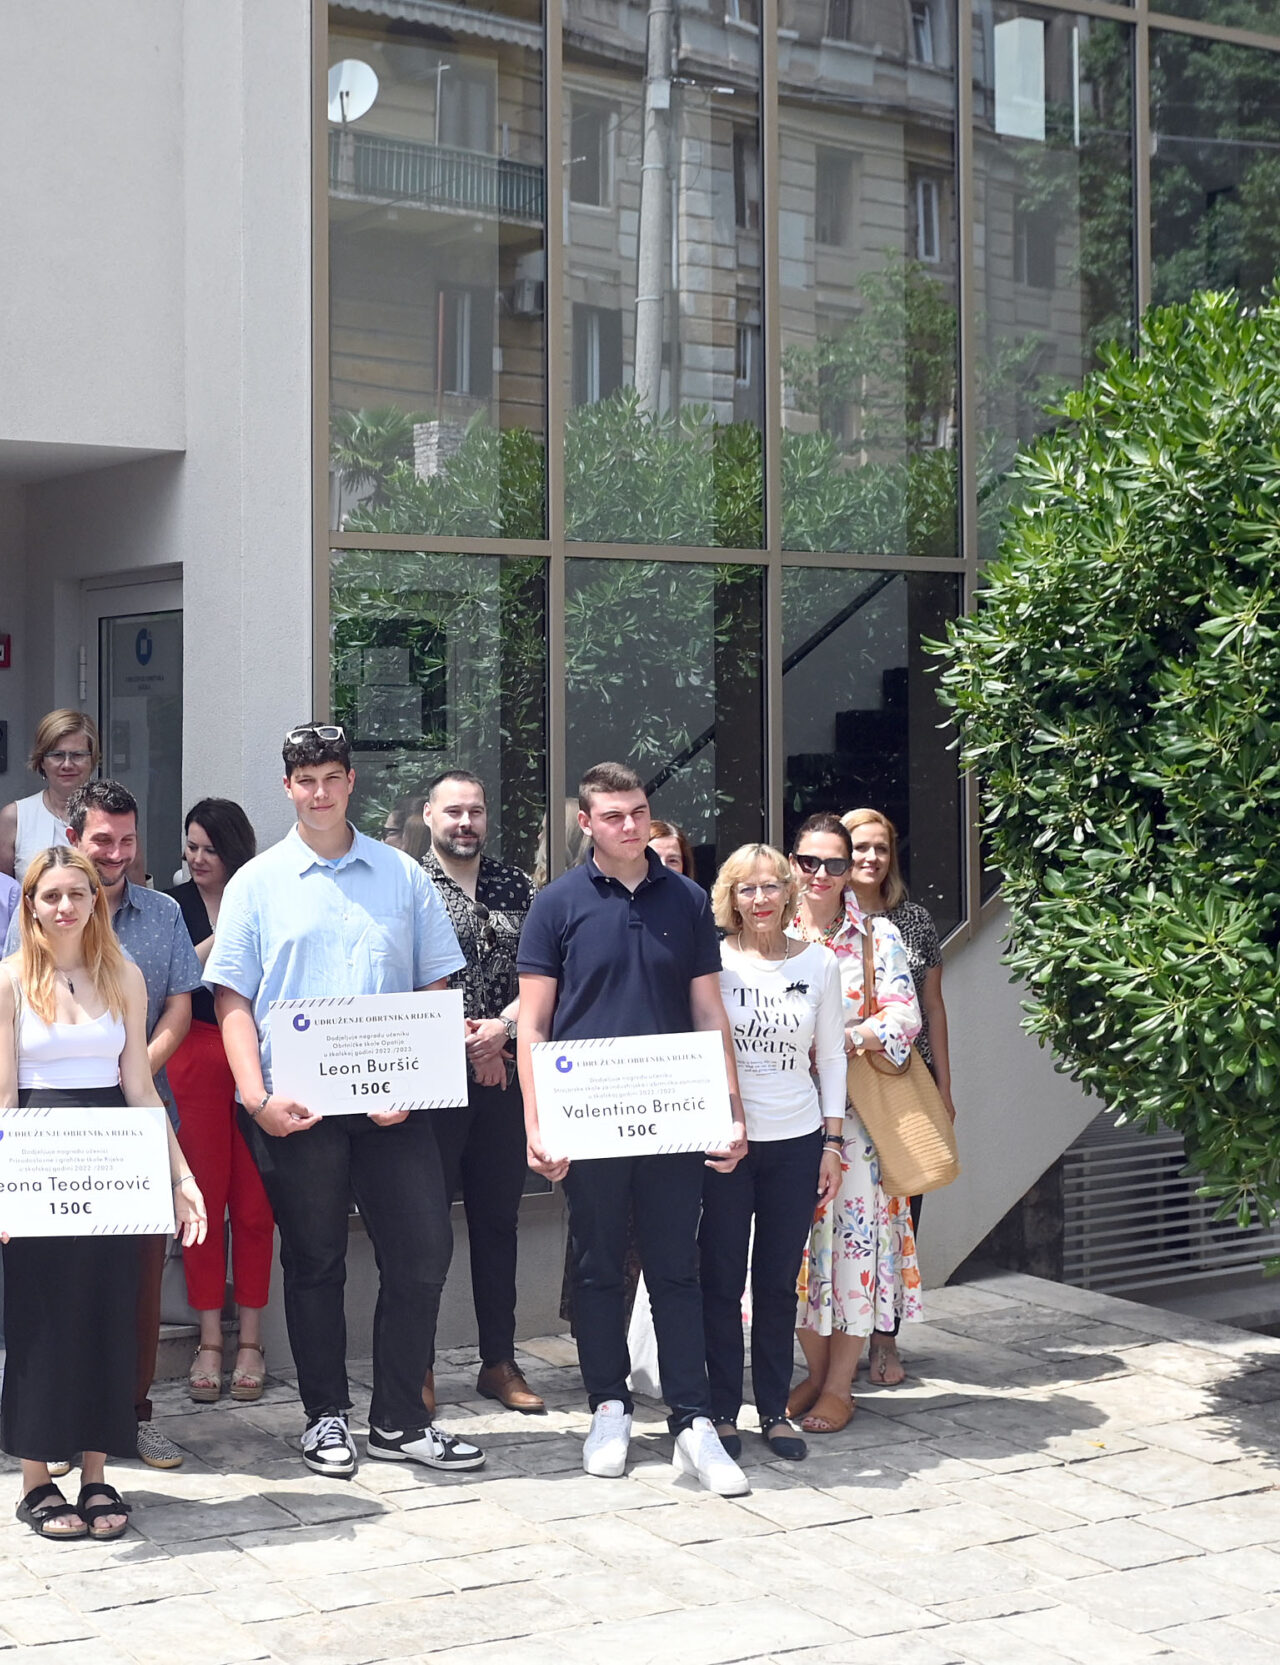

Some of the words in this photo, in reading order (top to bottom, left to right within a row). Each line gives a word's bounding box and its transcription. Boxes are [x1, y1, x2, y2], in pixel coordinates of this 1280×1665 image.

[314, 1015, 364, 1026] UDRUŽENJE
[365, 1014, 409, 1023] OBRTNIKA
[410, 1012, 442, 1020] RIJEKA
[734, 1019, 776, 1038] she
[734, 1038, 797, 1053] wears
[319, 1062, 361, 1076] Leon
[367, 1057, 419, 1072] Buršić
[781, 1054, 797, 1071] it
[350, 1081, 391, 1095] 150€
[562, 1101, 647, 1119] Valentino
[653, 1097, 706, 1113] Brnčić
[617, 1123, 658, 1137] 150€
[49, 1175, 150, 1192] Teodorović
[49, 1202, 93, 1215] 150€
